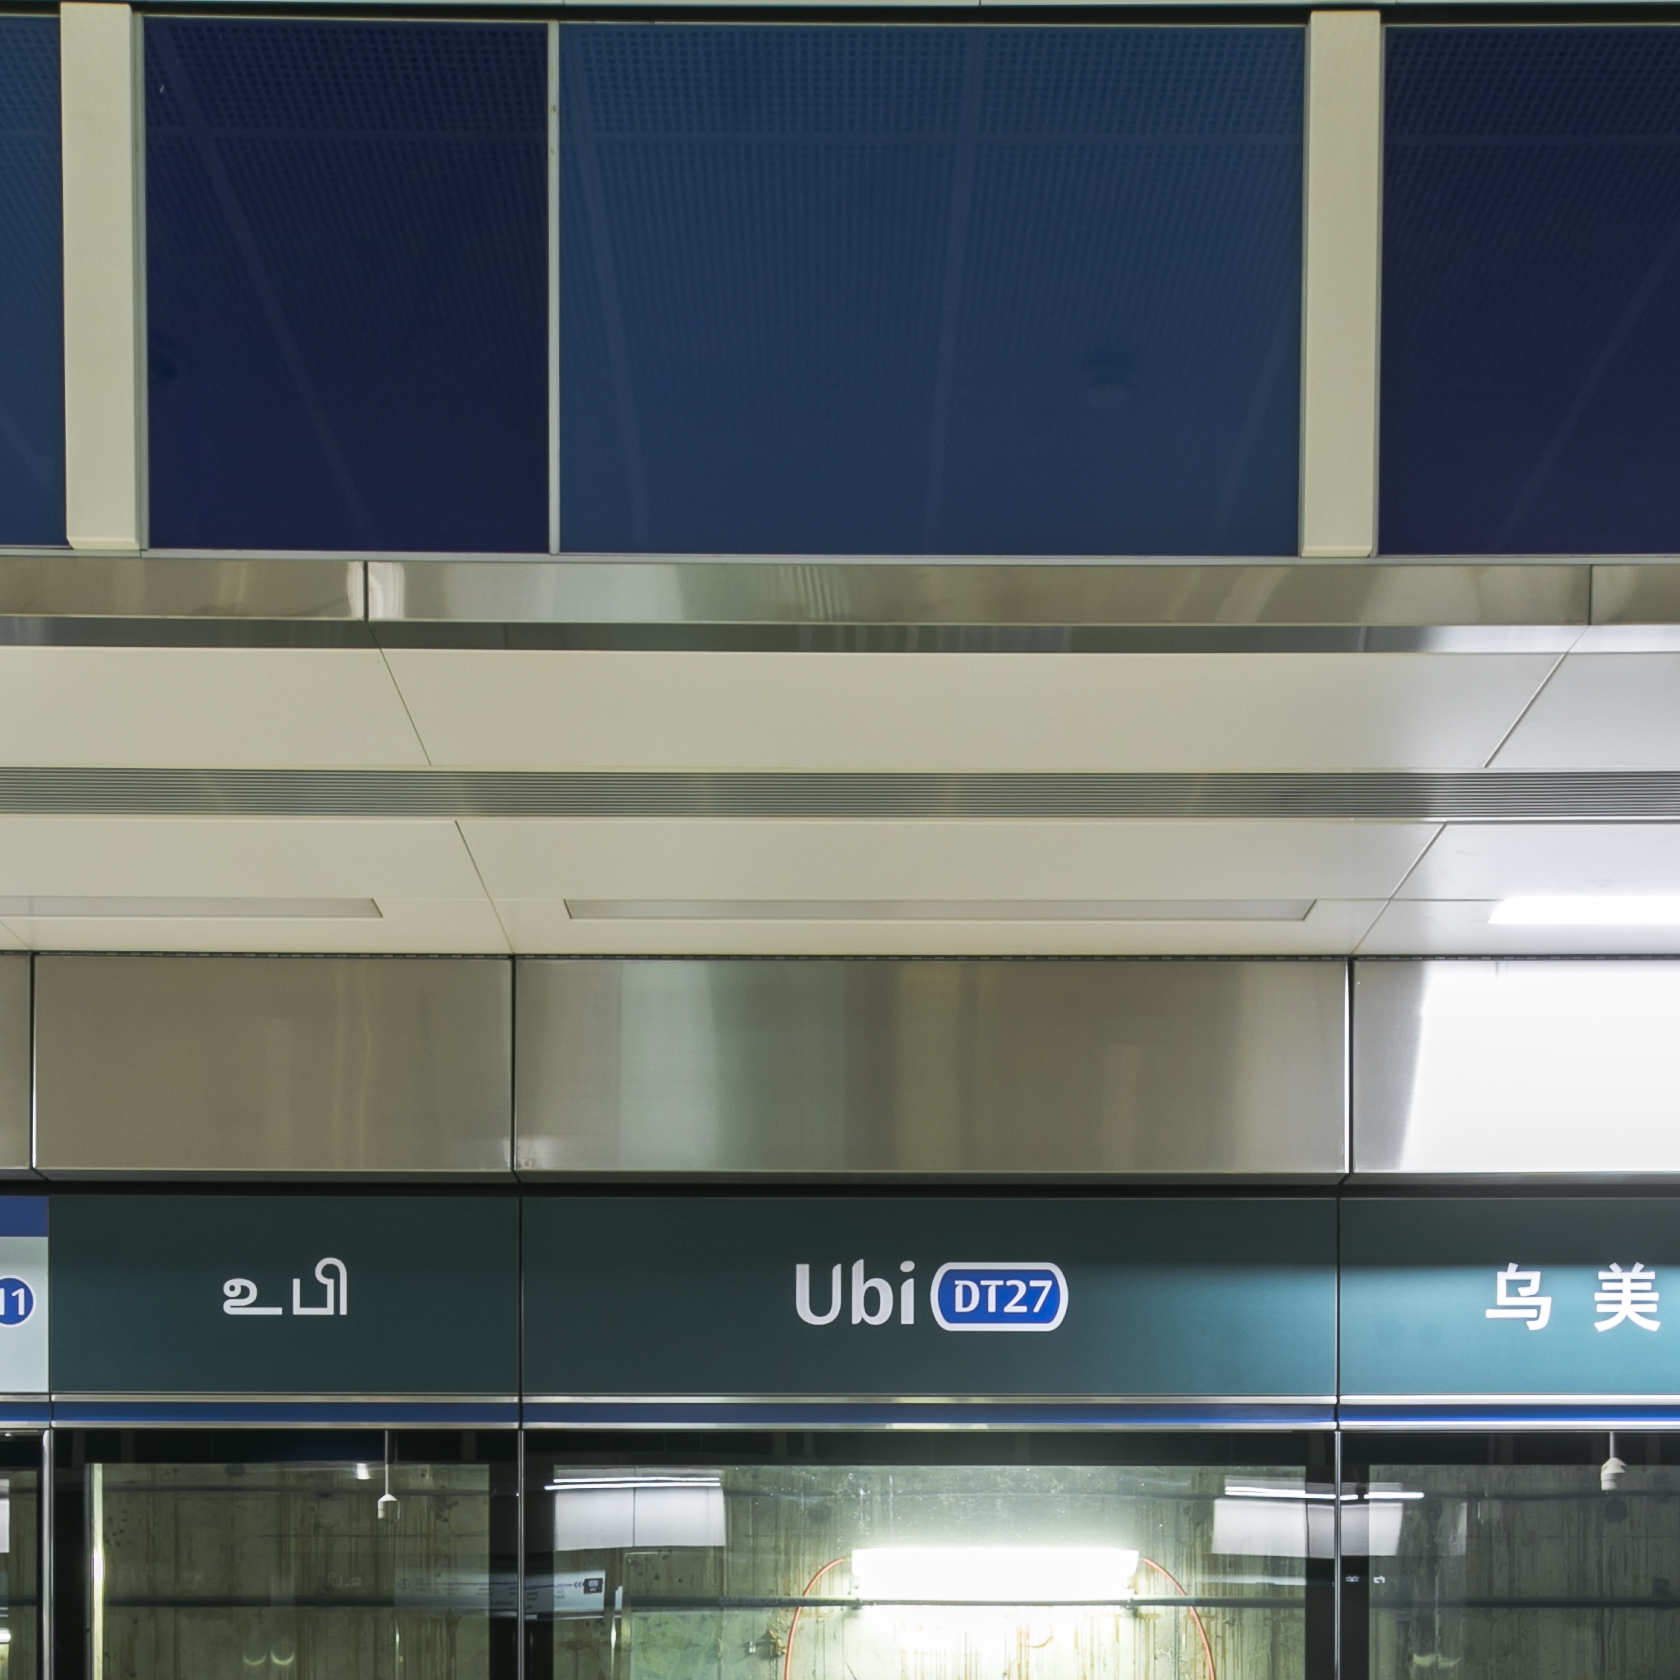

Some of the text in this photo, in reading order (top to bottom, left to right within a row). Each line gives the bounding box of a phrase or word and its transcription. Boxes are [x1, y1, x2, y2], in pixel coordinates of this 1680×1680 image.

[223, 1257, 348, 1316] உபி
[795, 1258, 1053, 1326] Ubi DT27
[1485, 1262, 1662, 1333] 乌美
